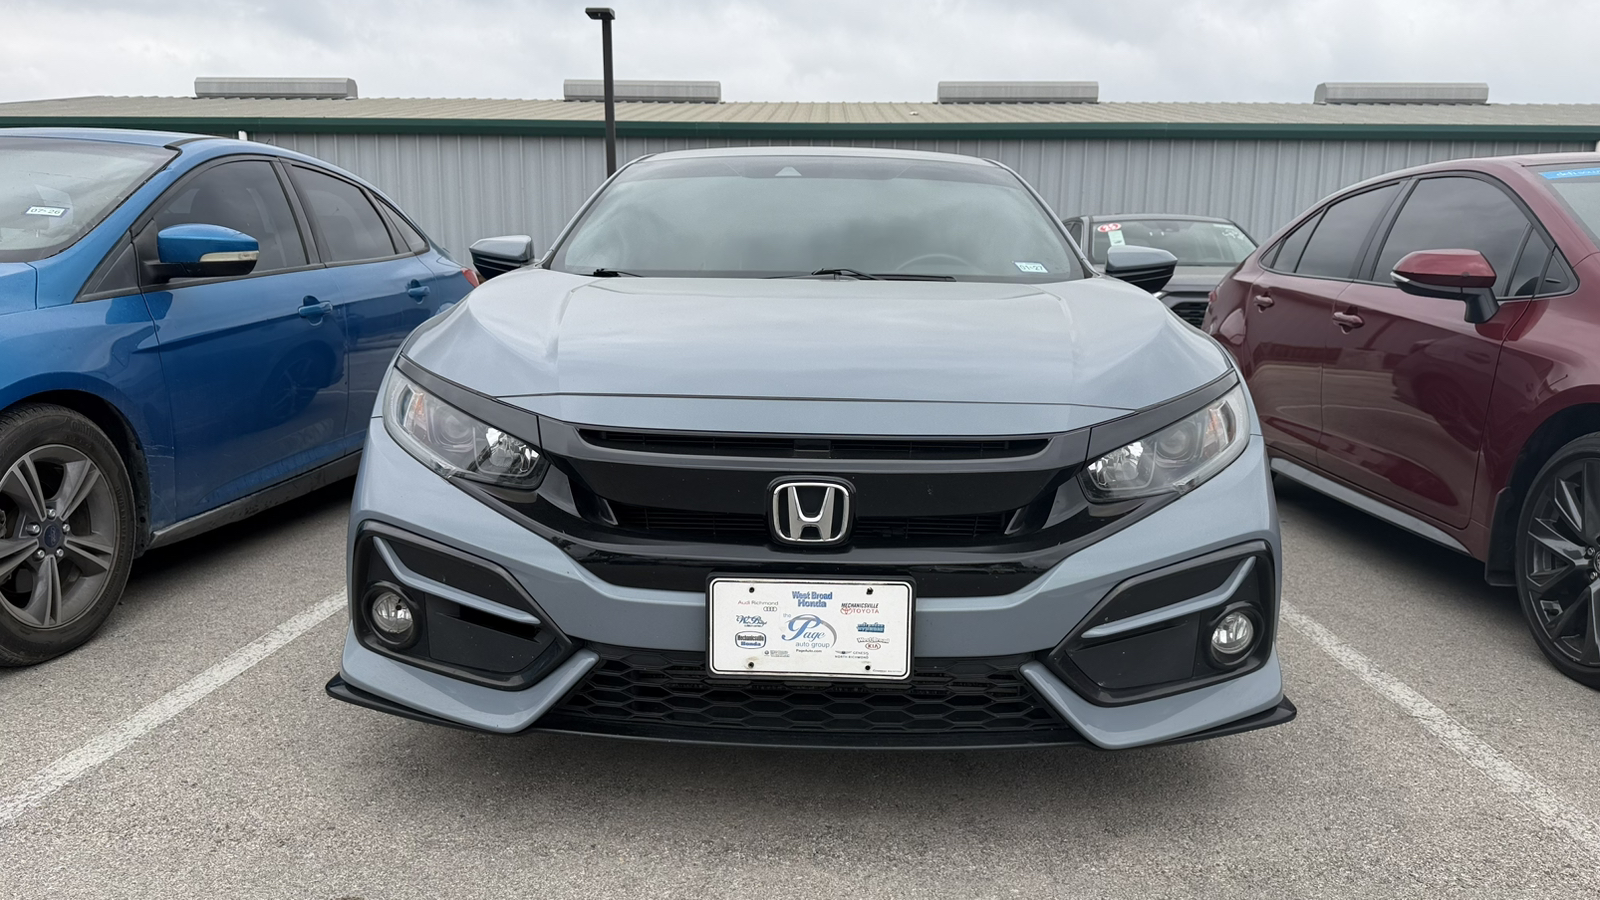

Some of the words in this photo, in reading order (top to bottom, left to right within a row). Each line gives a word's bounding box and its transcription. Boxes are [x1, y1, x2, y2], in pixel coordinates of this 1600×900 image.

[792, 591, 810, 599] West
[811, 591, 833, 600] Broad
[797, 599, 827, 608] Honda
[781, 613, 826, 643] Page
[811, 641, 830, 649] group
